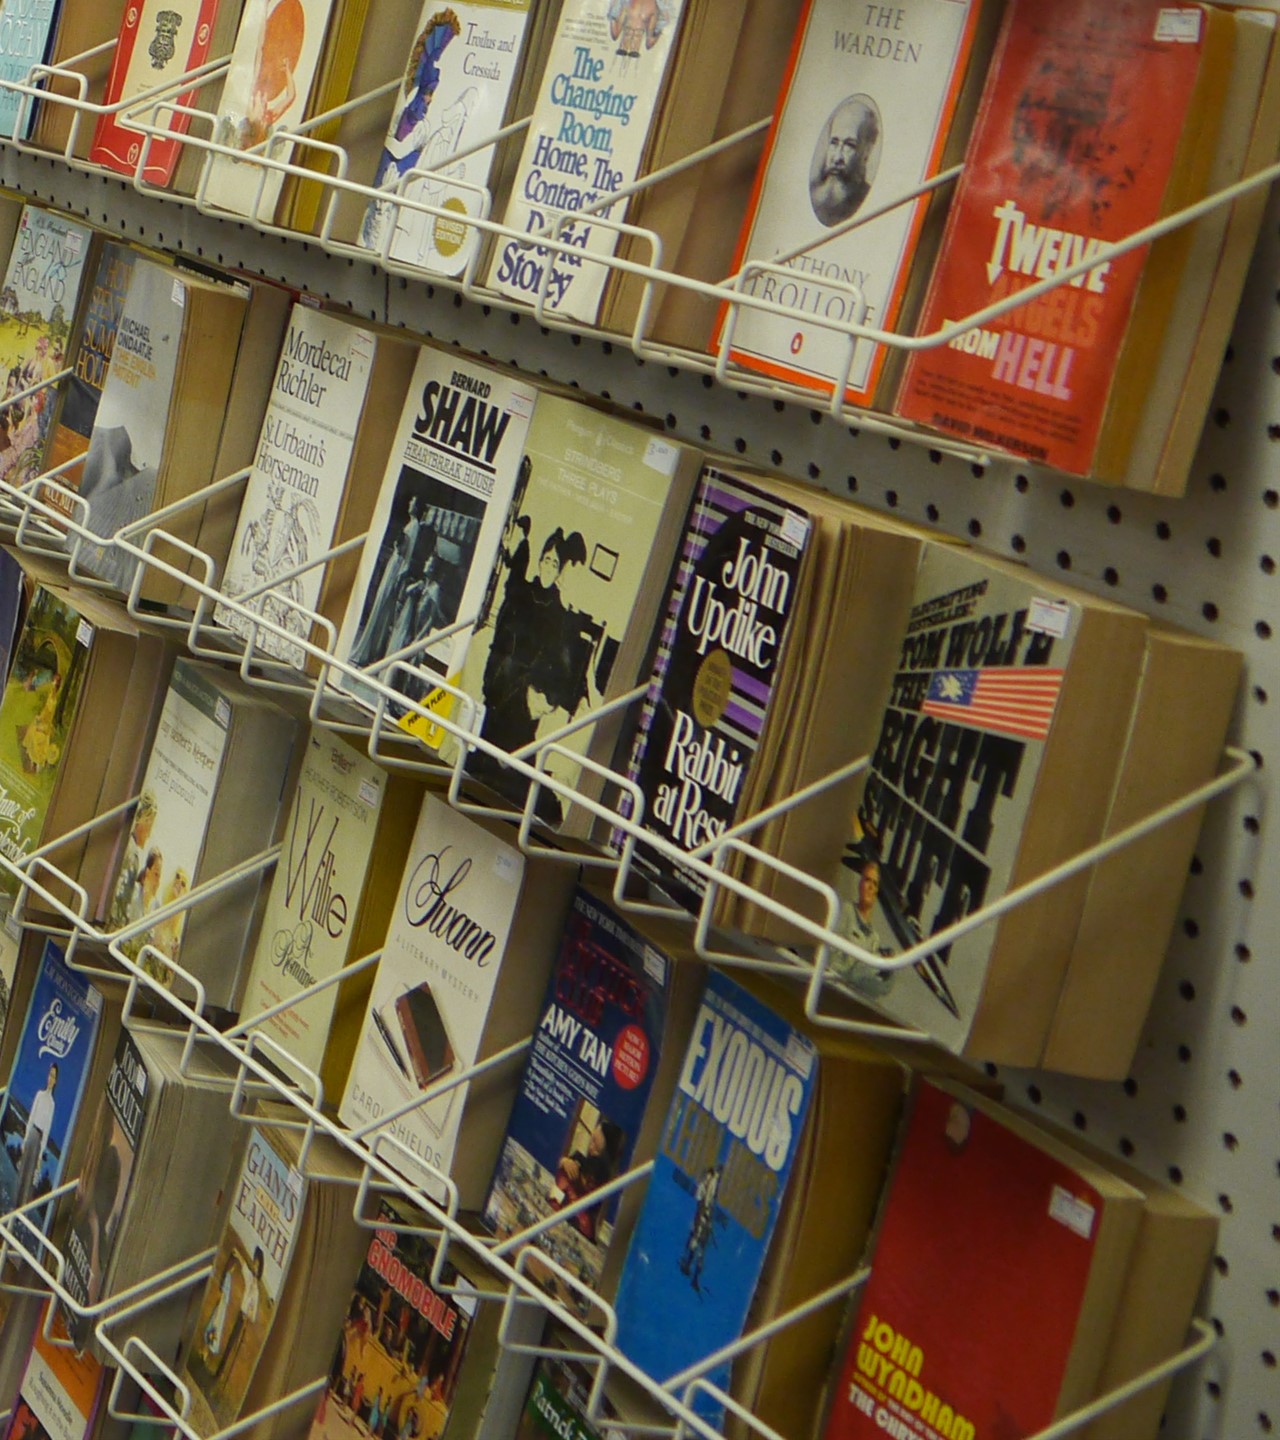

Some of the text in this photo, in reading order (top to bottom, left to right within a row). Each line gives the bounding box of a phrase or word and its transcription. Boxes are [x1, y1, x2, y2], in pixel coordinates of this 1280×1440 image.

[465, 22, 515, 54] Troilus and
[833, 28, 924, 64] WARDEN
[862, 2, 907, 32] THE
[463, 53, 502, 82] Cressida
[573, 47, 605, 82] The
[551, 76, 638, 126] Changing
[532, 135, 625, 193] Home, The
[557, 116, 615, 158] Room,
[524, 170, 618, 220] Contractor
[497, 244, 574, 308] Storey
[771, 246, 871, 288] ANTHONY
[985, 199, 1118, 295] TWELVE
[284, 324, 352, 383] Mordecai
[992, 330, 1075, 402] HELL
[275, 359, 327, 410] Richler
[450, 370, 492, 400] BERNARD
[262, 415, 328, 469] St. Urbain's
[414, 378, 512, 464] SHAW
[931, 411, 1050, 461] DAVID WILKERSON
[256, 443, 320, 499] Horseman
[403, 438, 498, 496] HEARTBREAK HOUSE
[723, 537, 793, 615] John
[687, 573, 776, 670] Updike
[900, 630, 944, 671] TOM
[945, 606, 1058, 668] WOLFE
[890, 672, 932, 711] THE
[666, 709, 743, 807] Rabbit
[873, 708, 1027, 855] RIGHT
[653, 778, 729, 853] at Rest
[284, 786, 349, 939] Willie
[404, 845, 498, 967] Swann
[401, 940, 479, 1003] LITERARY MYSTERY
[37, 997, 81, 1044] Emily
[540, 1003, 613, 1078] AMY TAN
[678, 1003, 808, 1171] EXODUS
[389, 1119, 442, 1170] SHIELDS
[247, 1141, 299, 1223] GIANTS
[235, 1181, 289, 1269] EARTH
[367, 1239, 458, 1343] GNOMOBILE
[863, 1313, 925, 1378] JOHN
[848, 1382, 875, 1418] THE
[856, 1341, 977, 1440] WYNDHAM
